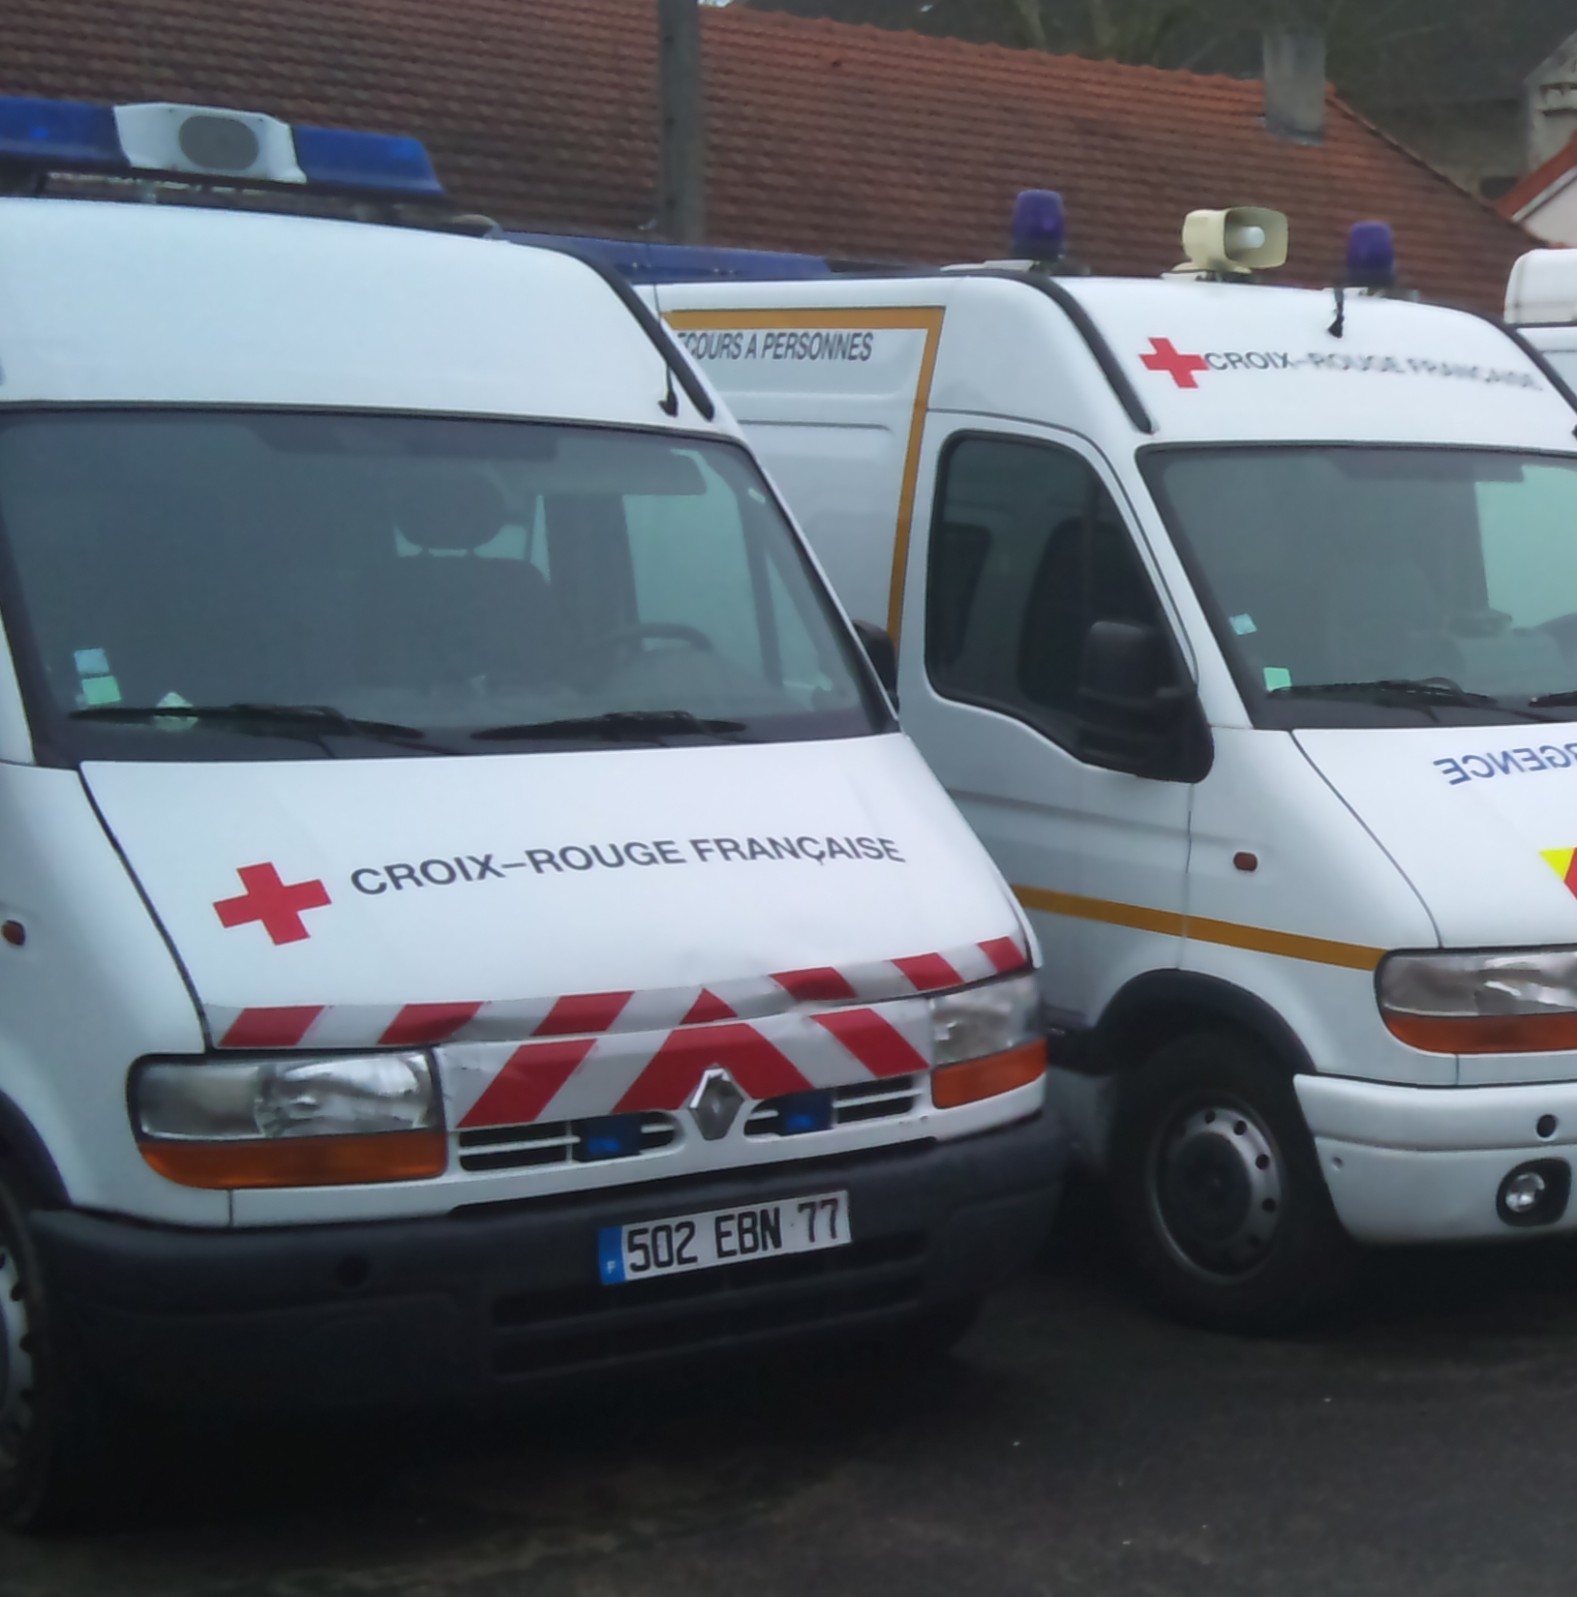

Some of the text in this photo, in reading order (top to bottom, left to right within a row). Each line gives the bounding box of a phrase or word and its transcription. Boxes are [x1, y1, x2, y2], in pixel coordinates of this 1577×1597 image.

[744, 332, 757, 360] A
[760, 332, 873, 361] PERSONNES
[1203, 350, 1406, 374] CROIX-ROUGE
[350, 835, 906, 896] CROIX-ROUGE FRANÇAISE
[626, 1220, 698, 1273] 502
[714, 1206, 783, 1259] EBN
[797, 1197, 840, 1243] 77
